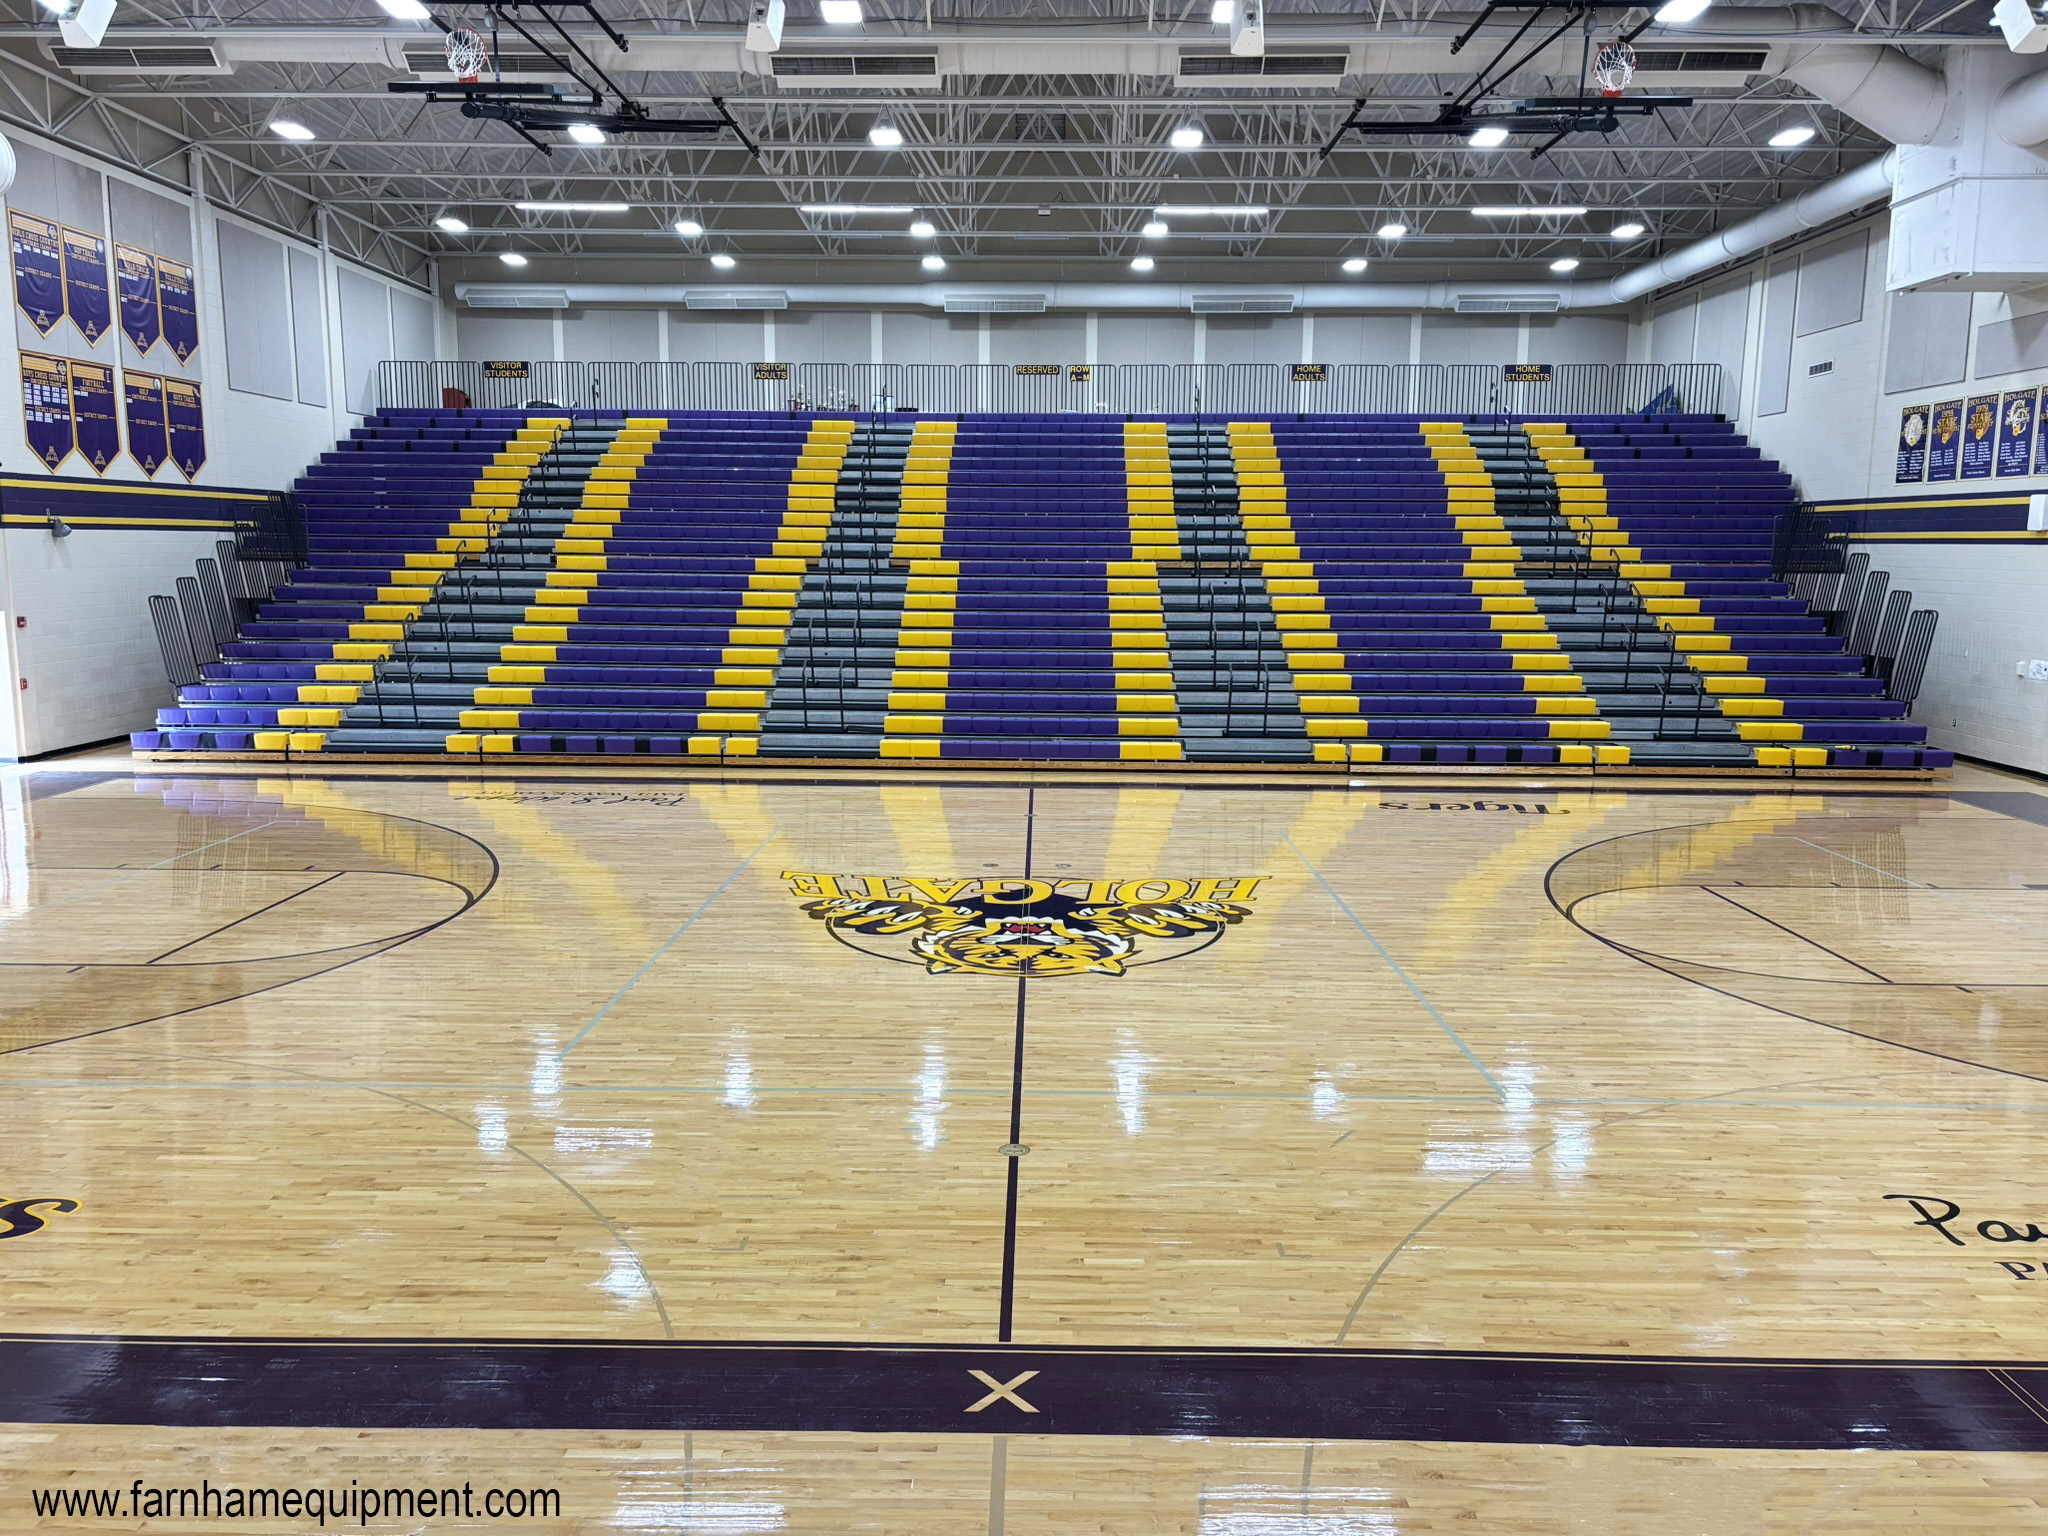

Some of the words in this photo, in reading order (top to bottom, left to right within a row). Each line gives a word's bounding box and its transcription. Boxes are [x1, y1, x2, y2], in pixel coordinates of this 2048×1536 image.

[1017, 366, 1059, 374] RESERVED
[1070, 365, 1090, 373] ROW
[1296, 365, 1322, 373] HOME
[1515, 365, 1541, 373] HOME
[1292, 373, 1326, 381] ADULTS
[1505, 373, 1550, 381] STUDENTS
[1968, 396, 1998, 408] HOLGATE
[1378, 800, 1572, 815] Tigers
[779, 870, 1274, 906] HOLGATE
